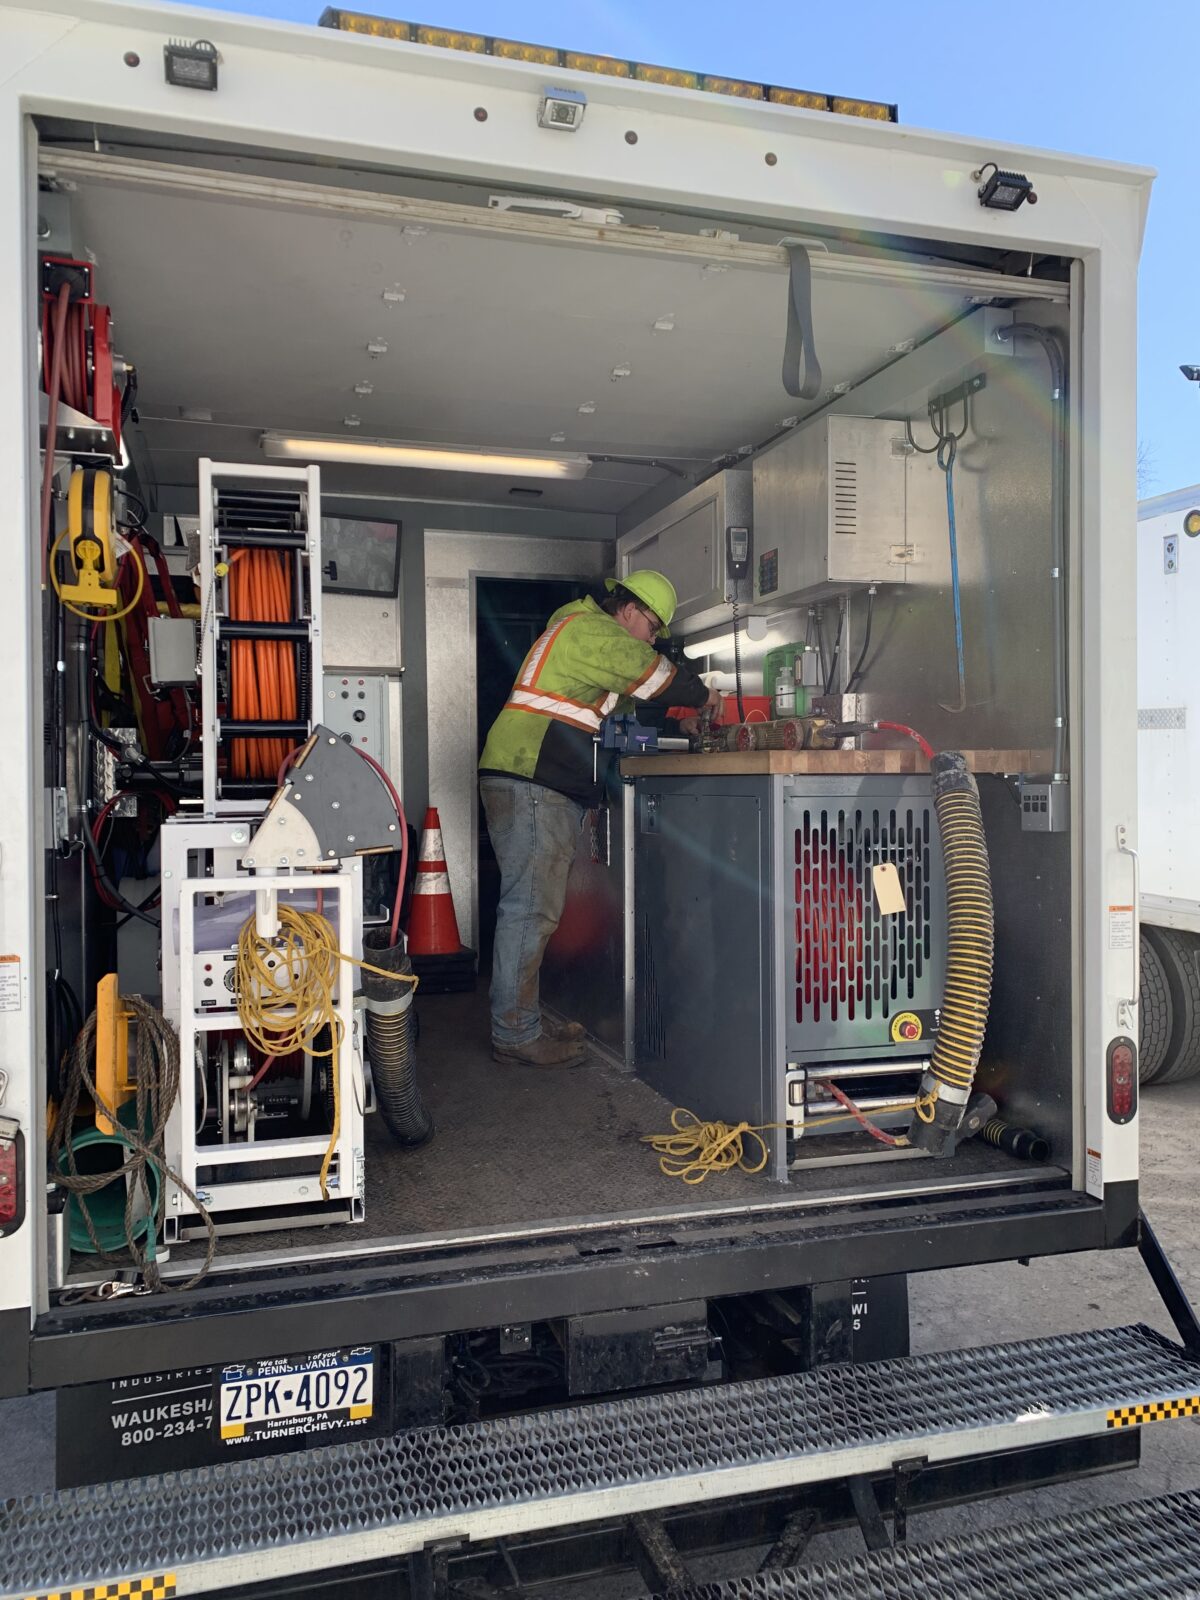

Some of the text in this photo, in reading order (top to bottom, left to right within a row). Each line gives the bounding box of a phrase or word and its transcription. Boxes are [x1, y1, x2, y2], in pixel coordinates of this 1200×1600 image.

[851, 1303, 868, 1315] WI
[853, 1319, 861, 1330] 5
[267, 1412, 329, 1429] Harrisburg, PA
